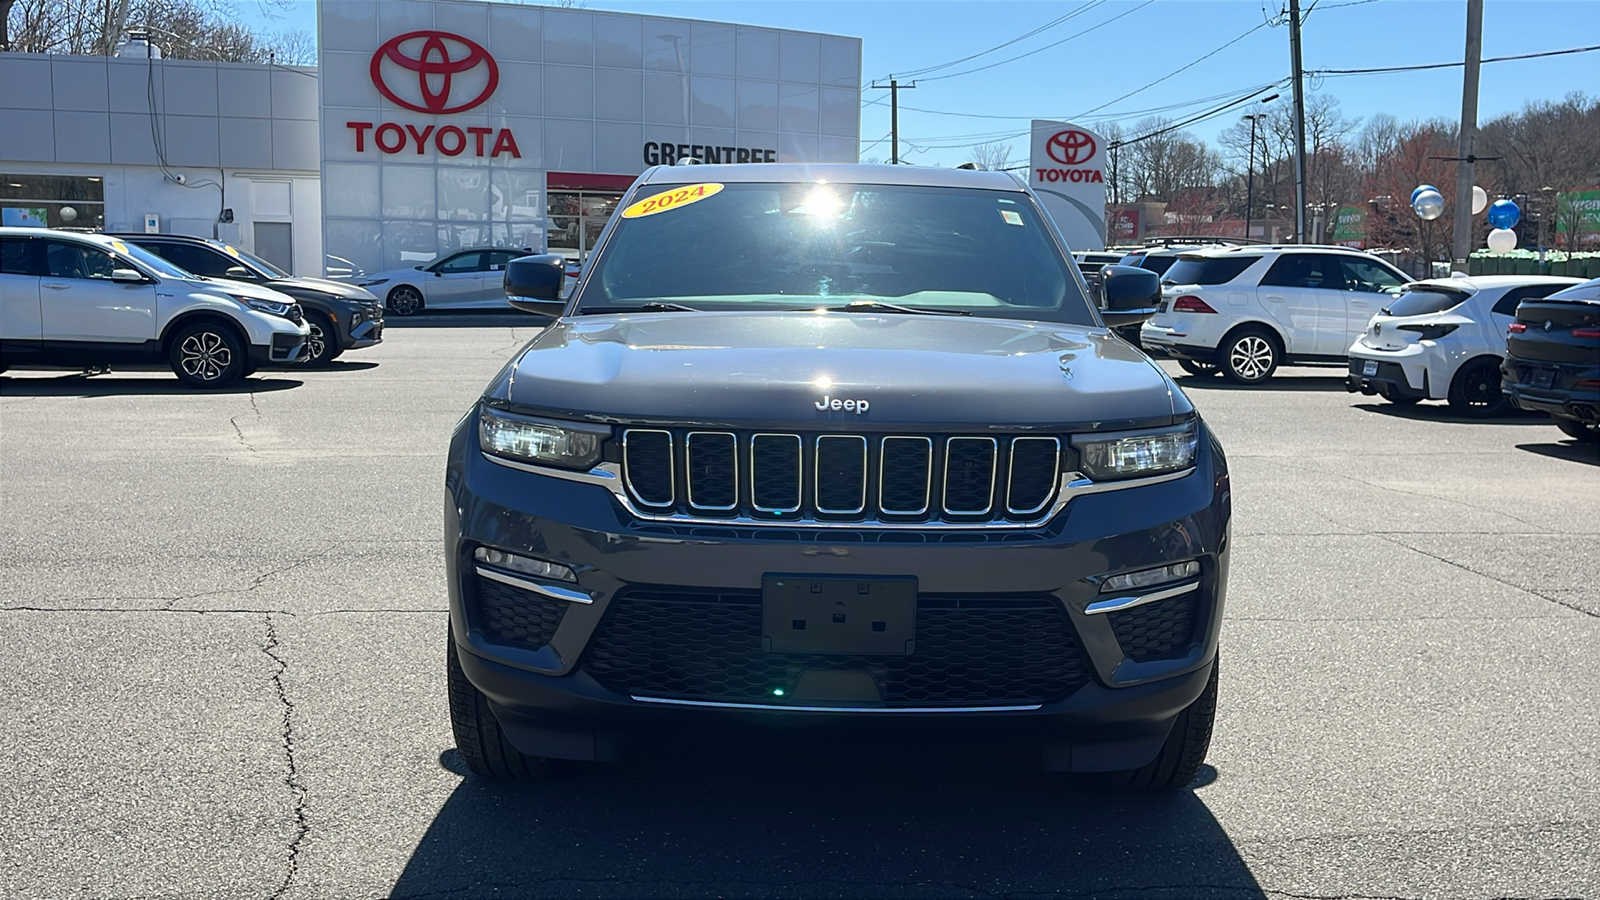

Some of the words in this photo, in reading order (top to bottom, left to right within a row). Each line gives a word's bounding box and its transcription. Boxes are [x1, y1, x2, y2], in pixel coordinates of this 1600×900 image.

[346, 121, 522, 159] TOYOTA
[1036, 168, 1104, 184] TOYOTA
[642, 185, 708, 214] 2024
[814, 394, 870, 415] Jeep
